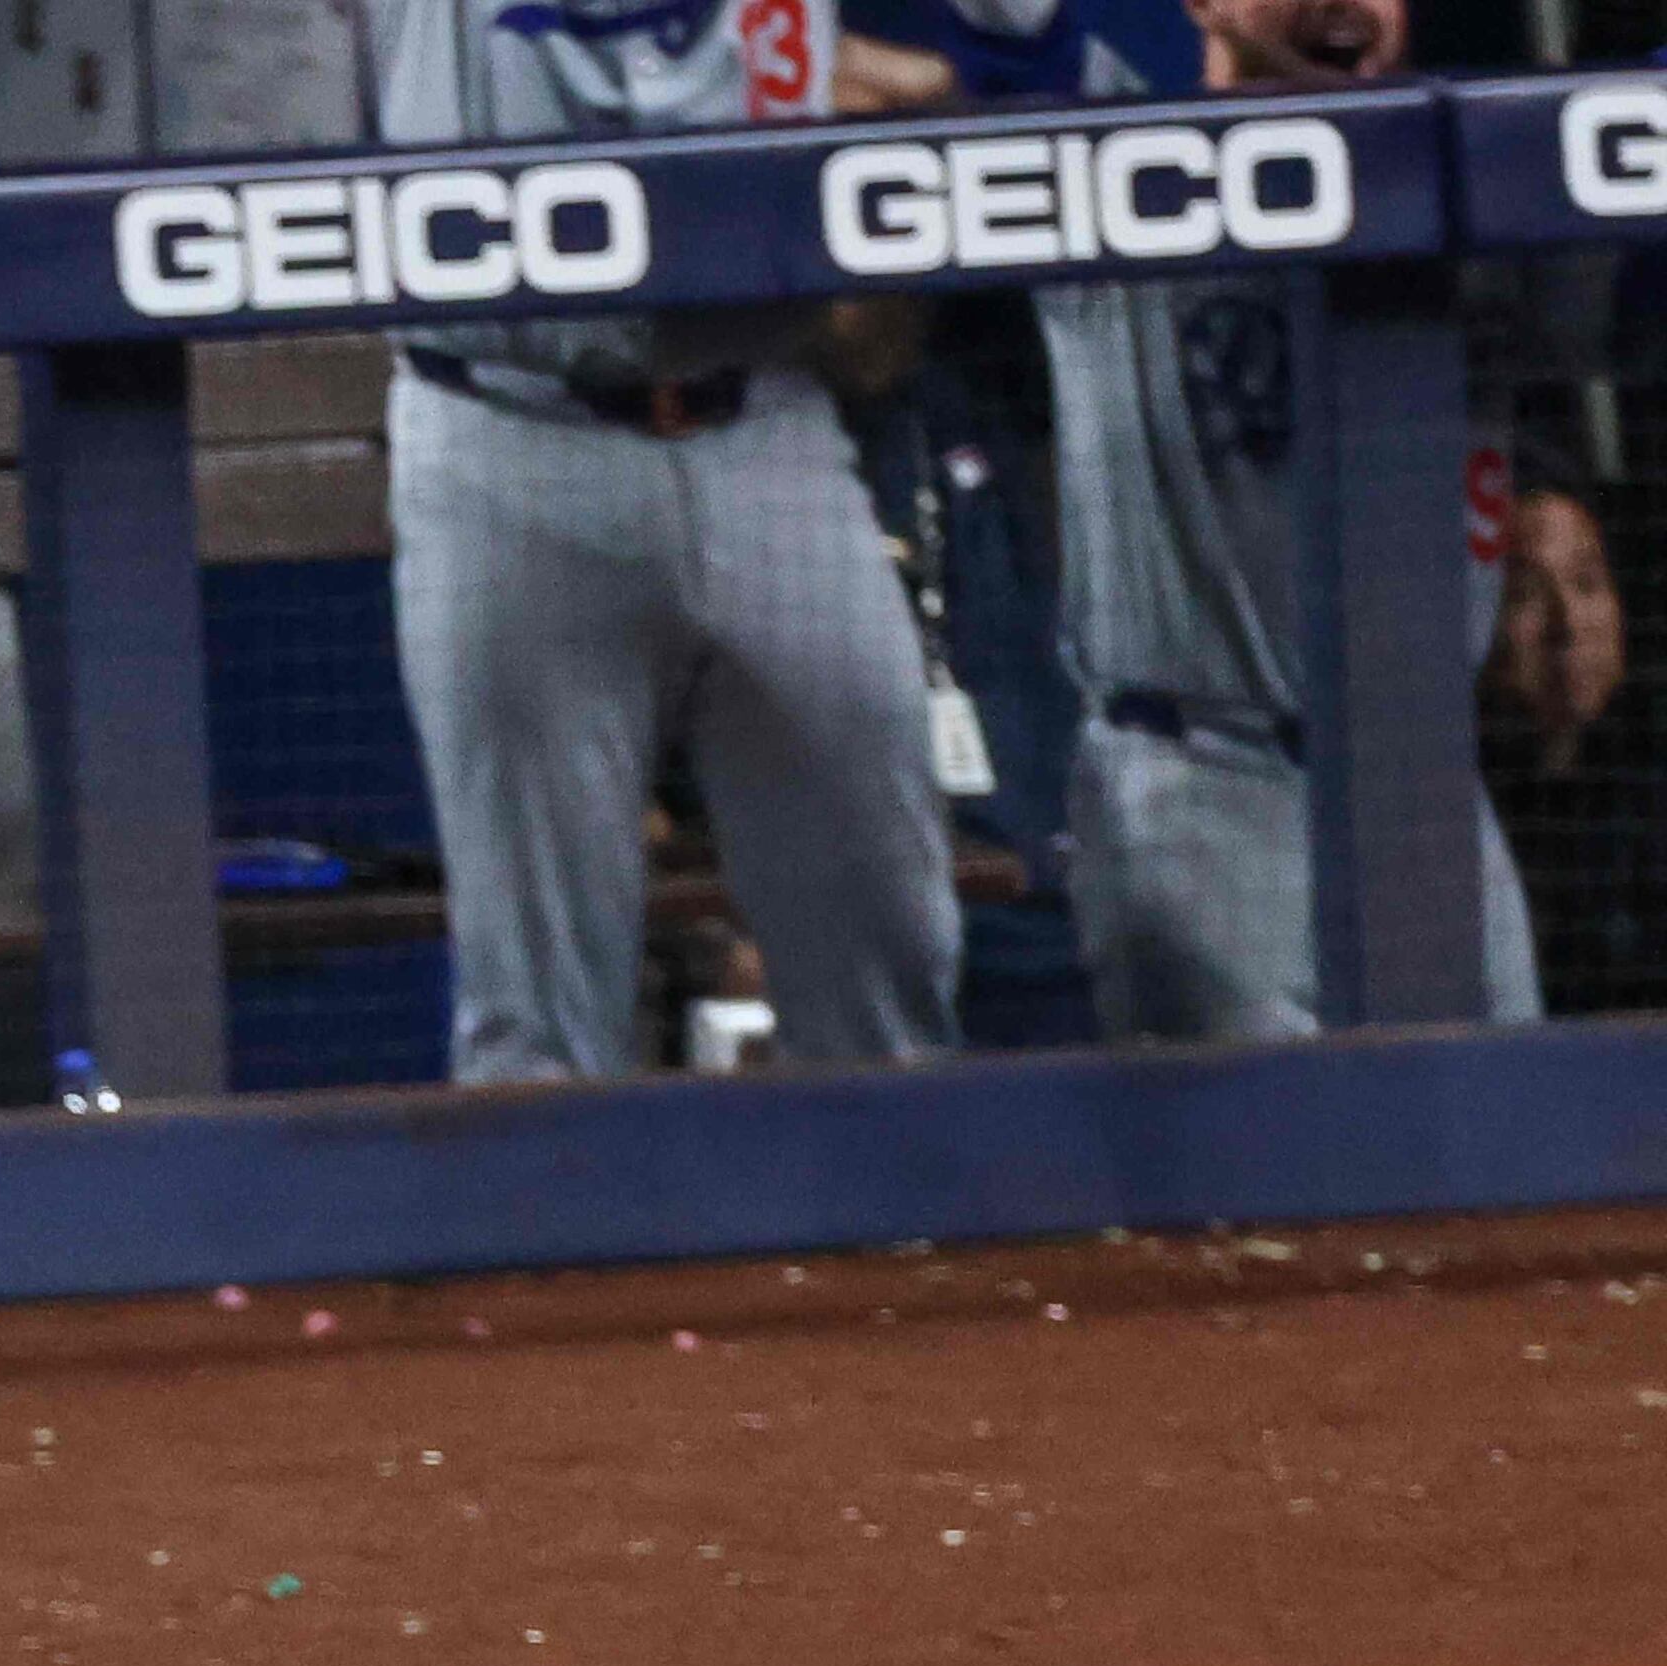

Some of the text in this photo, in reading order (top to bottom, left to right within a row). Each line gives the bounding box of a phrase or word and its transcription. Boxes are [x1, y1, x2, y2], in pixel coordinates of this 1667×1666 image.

[820, 119, 1352, 274] GEICO
[1559, 84, 1667, 215] G
[115, 161, 649, 318] GEICO
